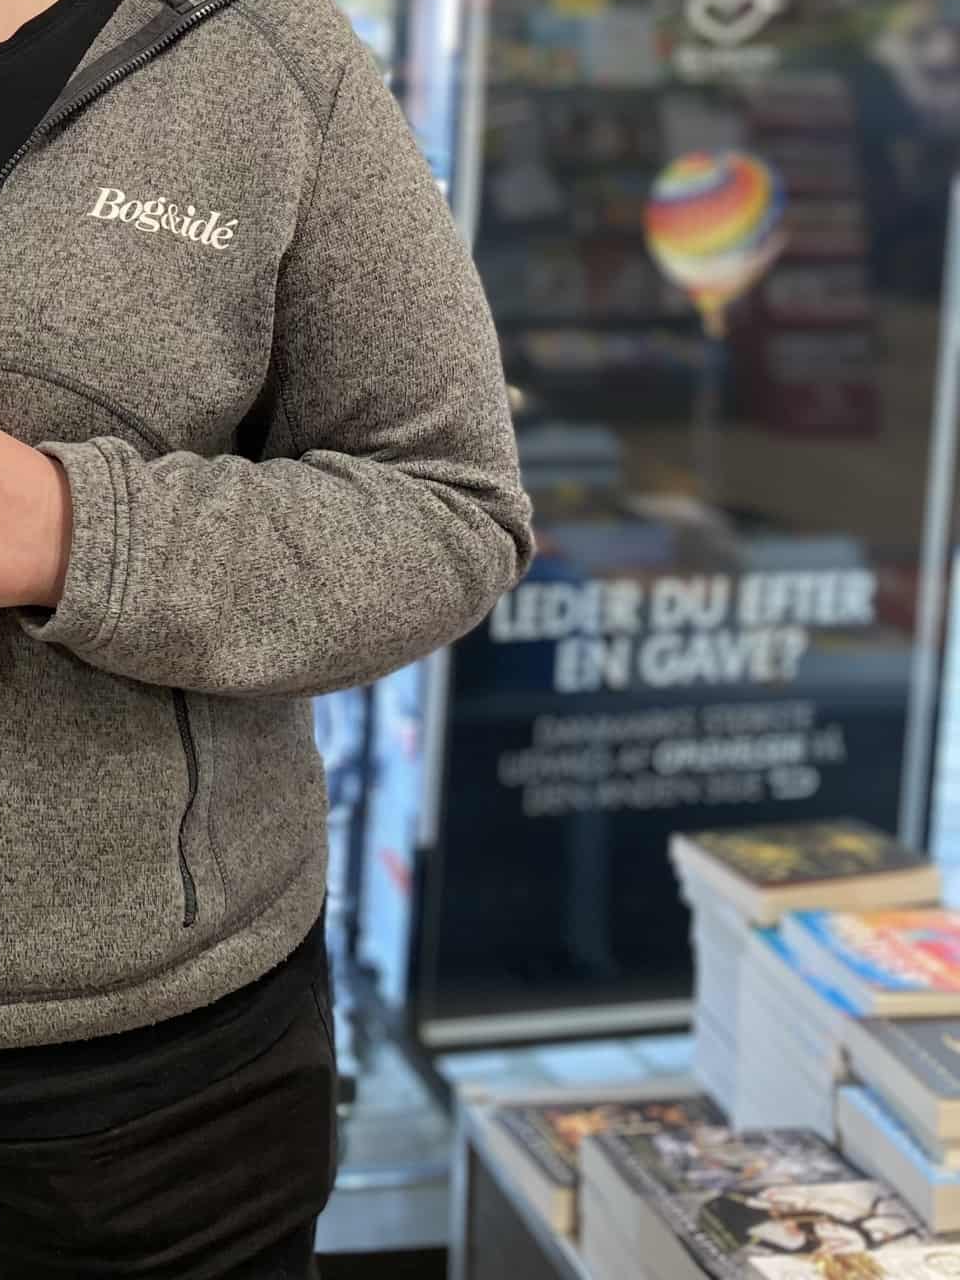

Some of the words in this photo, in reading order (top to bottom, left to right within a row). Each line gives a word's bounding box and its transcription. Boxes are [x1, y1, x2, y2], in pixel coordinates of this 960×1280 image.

[86, 186, 239, 250] Bog&idé
[489, 577, 639, 642] LEDER
[649, 572, 730, 634] DU
[737, 567, 878, 627] EFTER
[553, 634, 631, 693] EN
[640, 625, 809, 687] GAVE?
